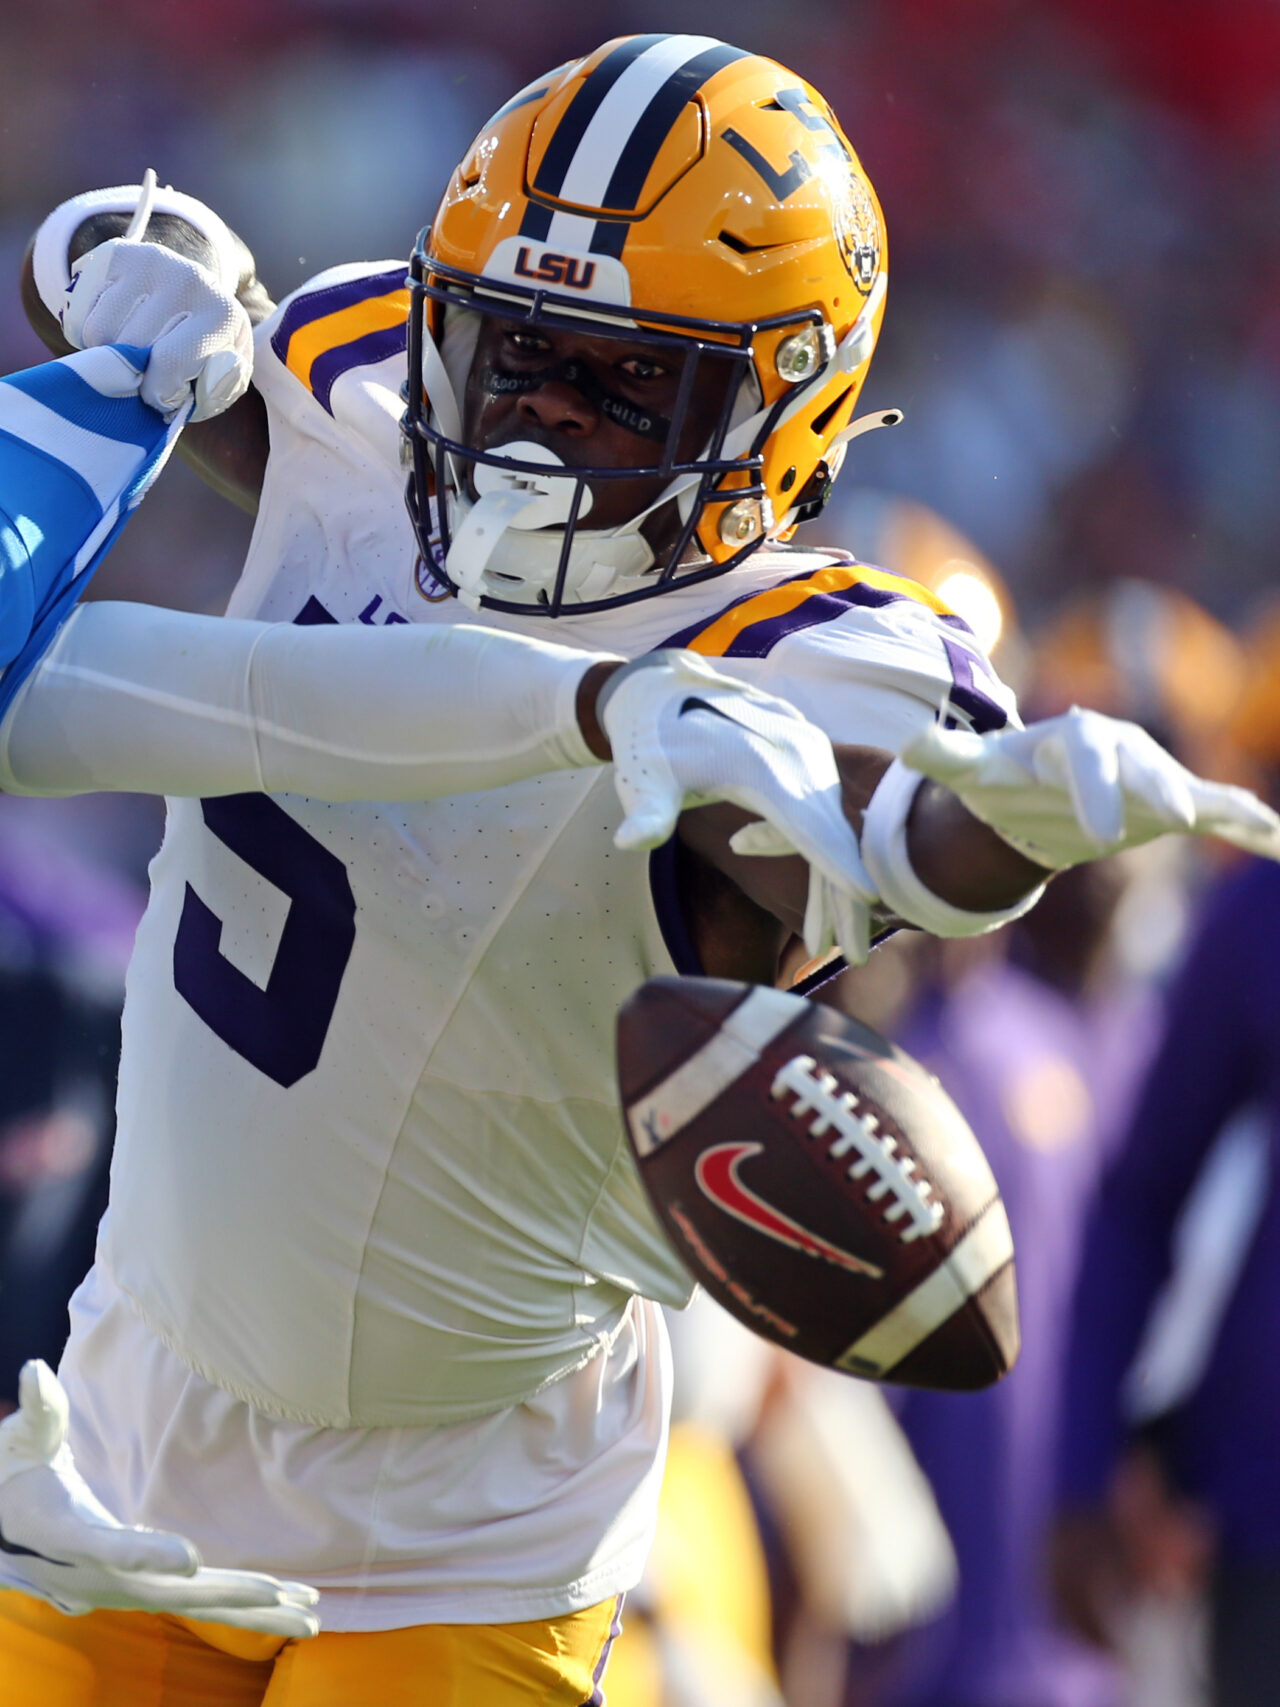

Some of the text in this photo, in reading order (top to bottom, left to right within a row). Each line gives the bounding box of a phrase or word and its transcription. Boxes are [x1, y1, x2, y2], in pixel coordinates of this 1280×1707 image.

[720, 88, 853, 202] LS
[514, 246, 596, 290] LSU
[602, 399, 652, 431] CHILD
